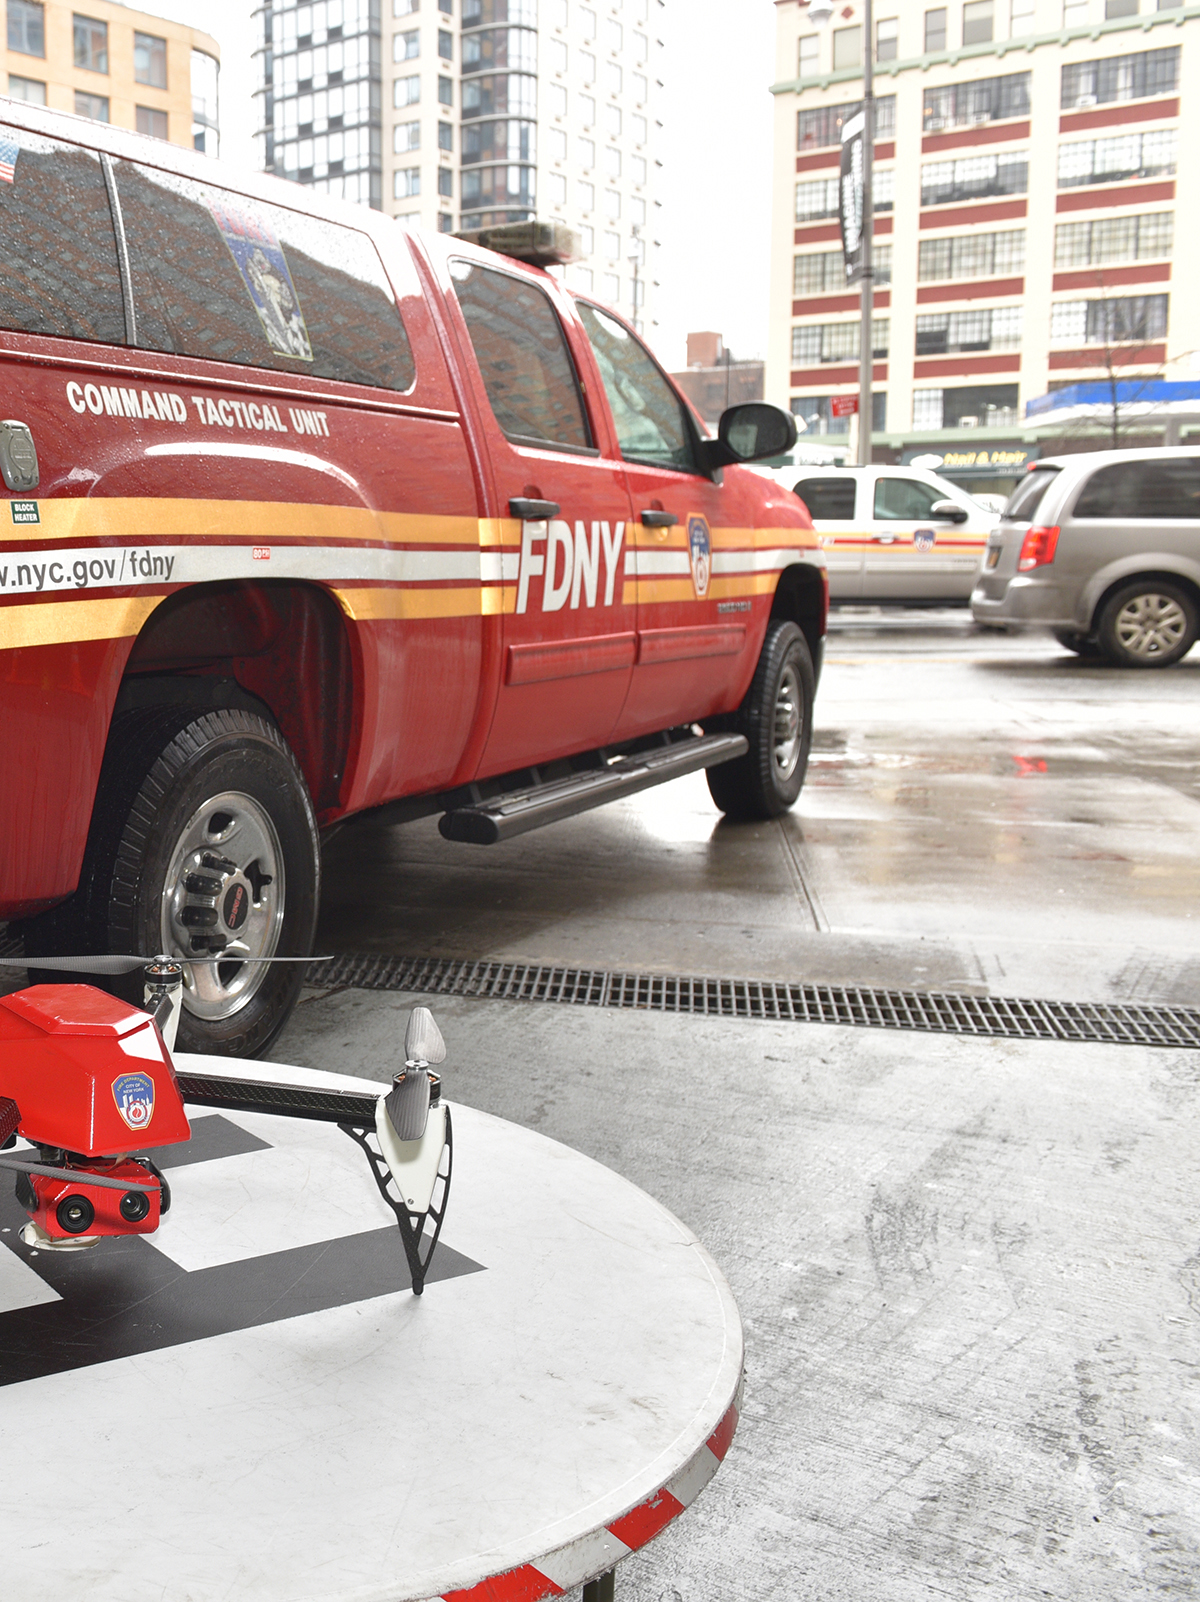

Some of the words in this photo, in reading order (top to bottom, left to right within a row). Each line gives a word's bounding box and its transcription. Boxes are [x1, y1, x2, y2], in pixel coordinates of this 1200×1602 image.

[66, 380, 187, 422] COMMAND
[191, 395, 288, 432] TACTICAL
[288, 407, 330, 437] UNIT
[943, 452, 976, 465] Nail
[976, 451, 989, 464] &
[991, 450, 1028, 464] Hair
[14, 503, 34, 512] BLOCK
[14, 513, 38, 522] HEATER
[253, 549, 262, 559] 80
[516, 518, 625, 614] FDNY
[228, 886, 243, 928] GMC
